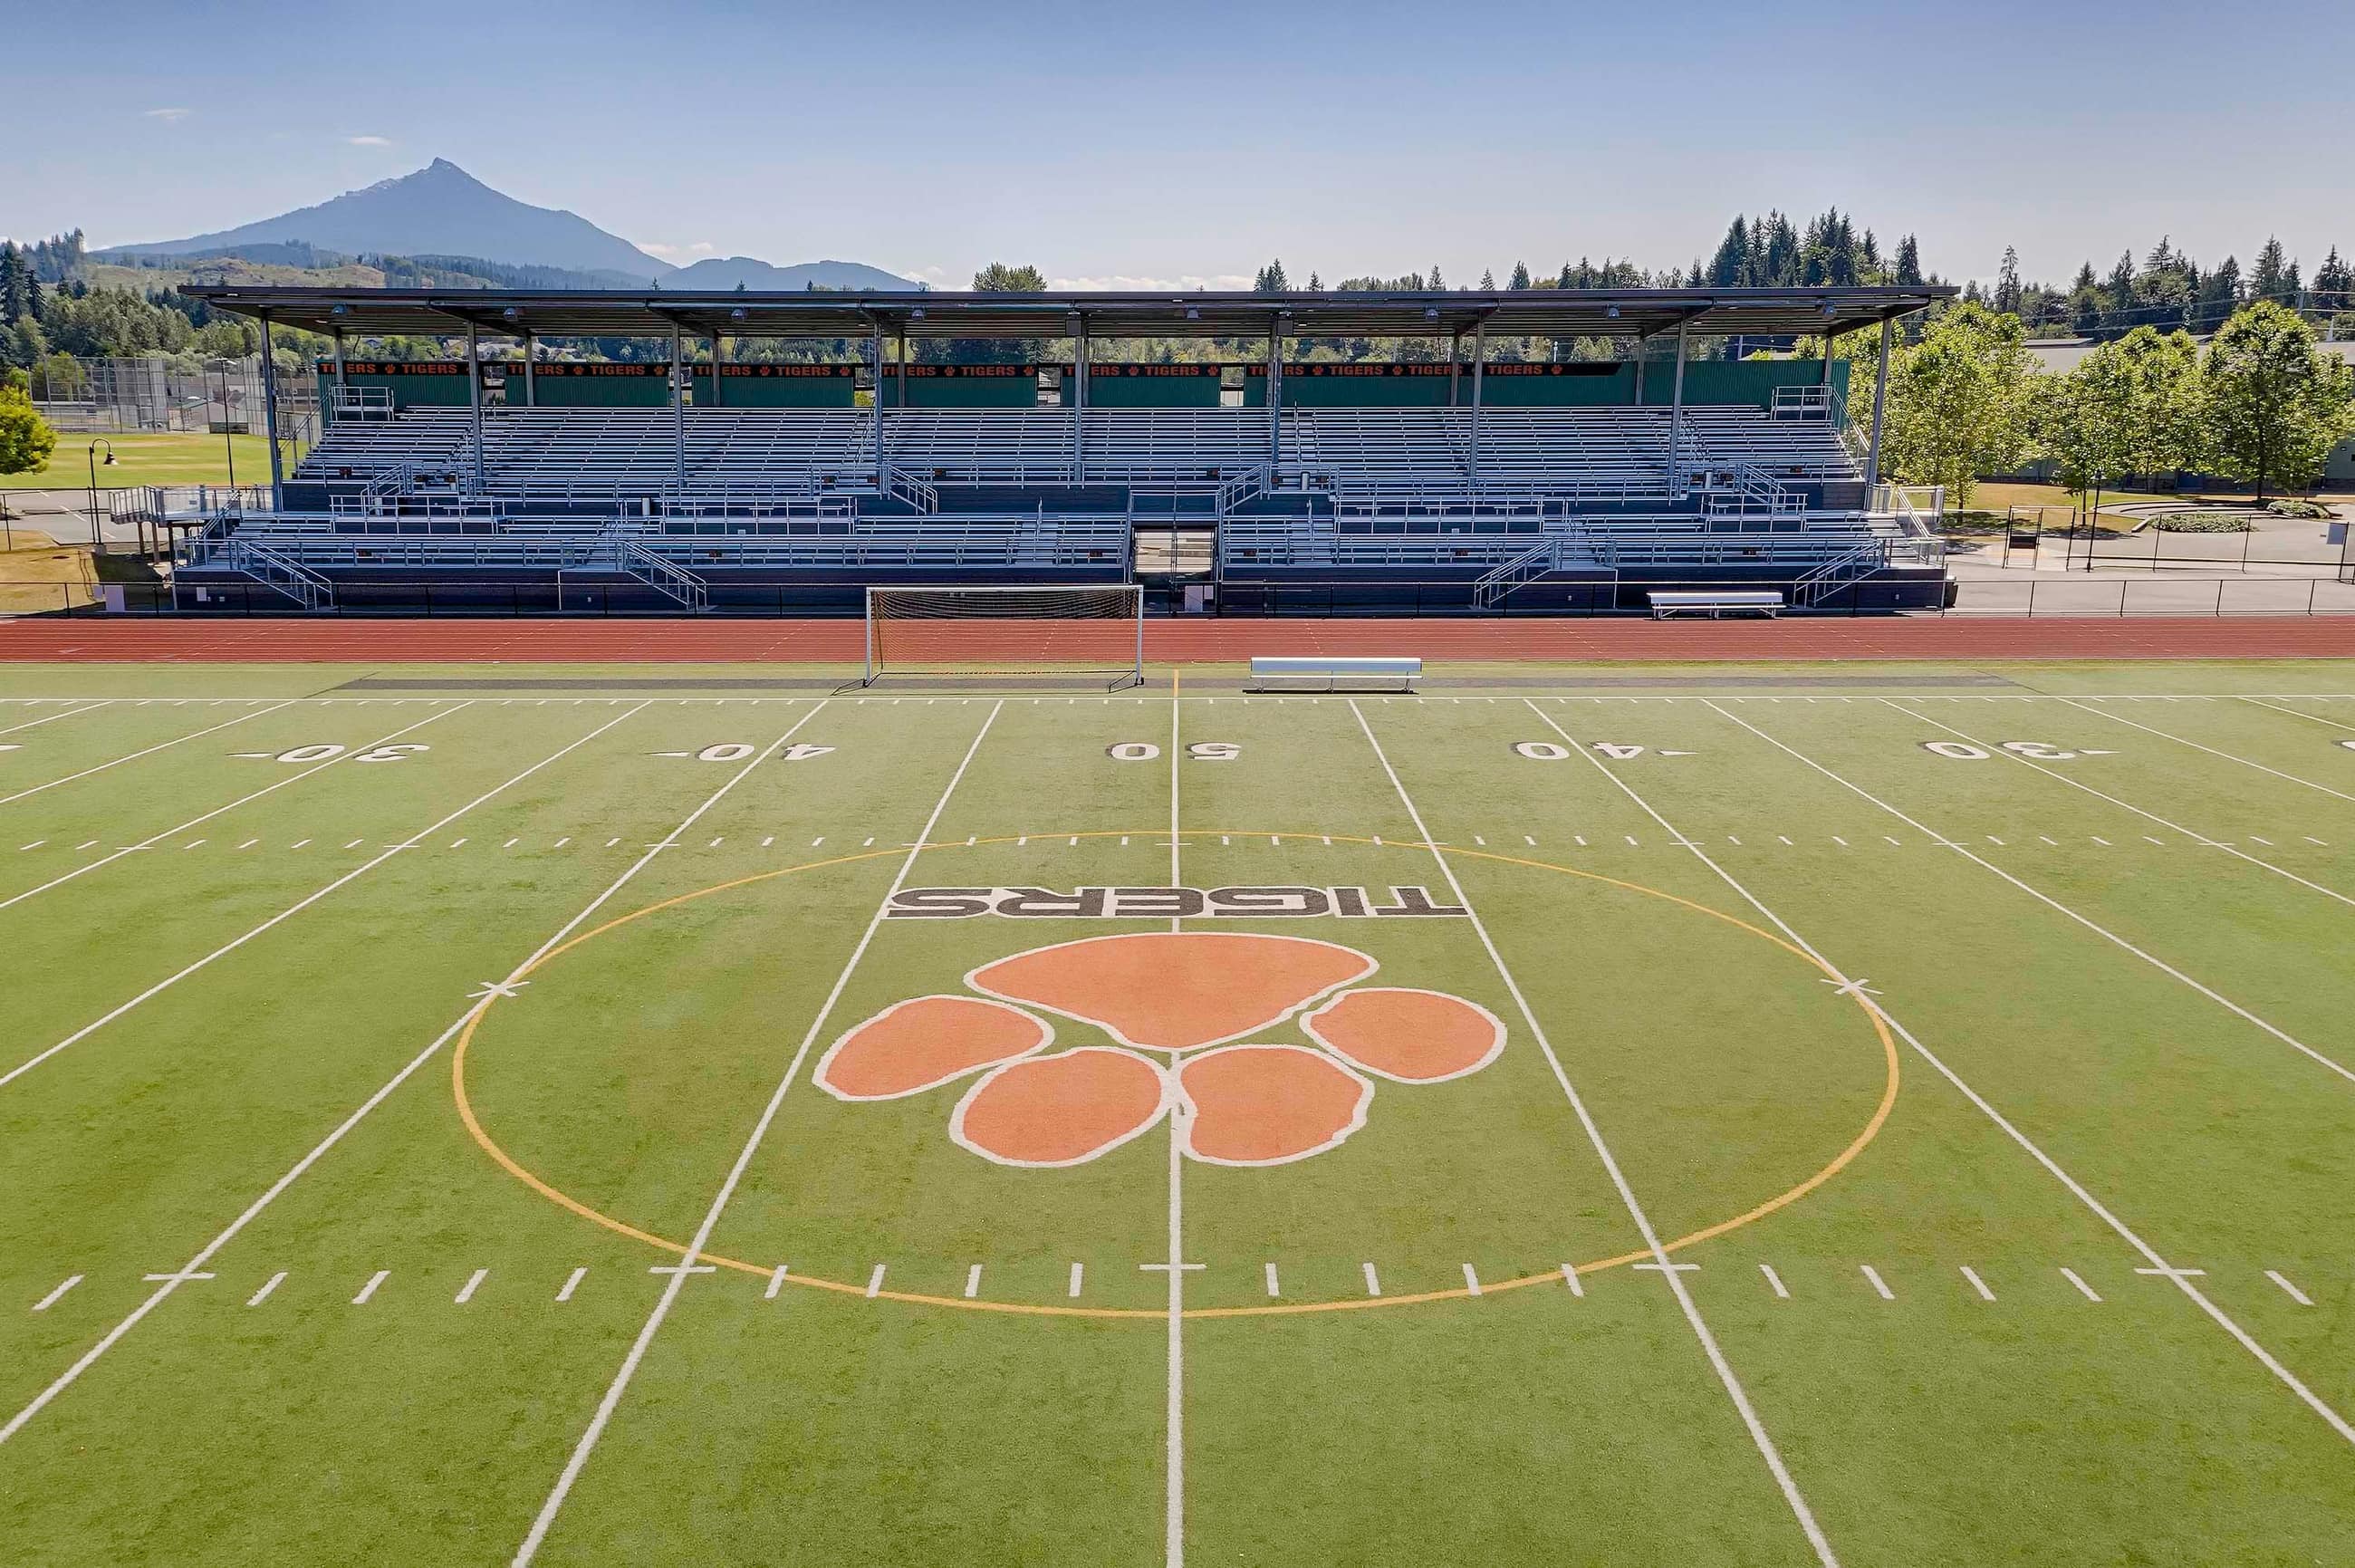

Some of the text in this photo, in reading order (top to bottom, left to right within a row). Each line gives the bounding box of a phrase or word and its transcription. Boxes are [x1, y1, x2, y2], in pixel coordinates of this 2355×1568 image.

[320, 363, 457, 374] TIERS TIGERS
[508, 364, 645, 375] TIERS TIGERS
[696, 365, 831, 376] TIERS TIGERS
[883, 366, 1015, 376] TIERS TIGERS
[1065, 365, 1199, 376] TERS TIGERS
[1249, 365, 1304, 376] TIRS
[1329, 365, 1383, 375] TIGERS
[1488, 364, 1543, 375] TIGERS
[884, 886, 1469, 919] TIGERS
